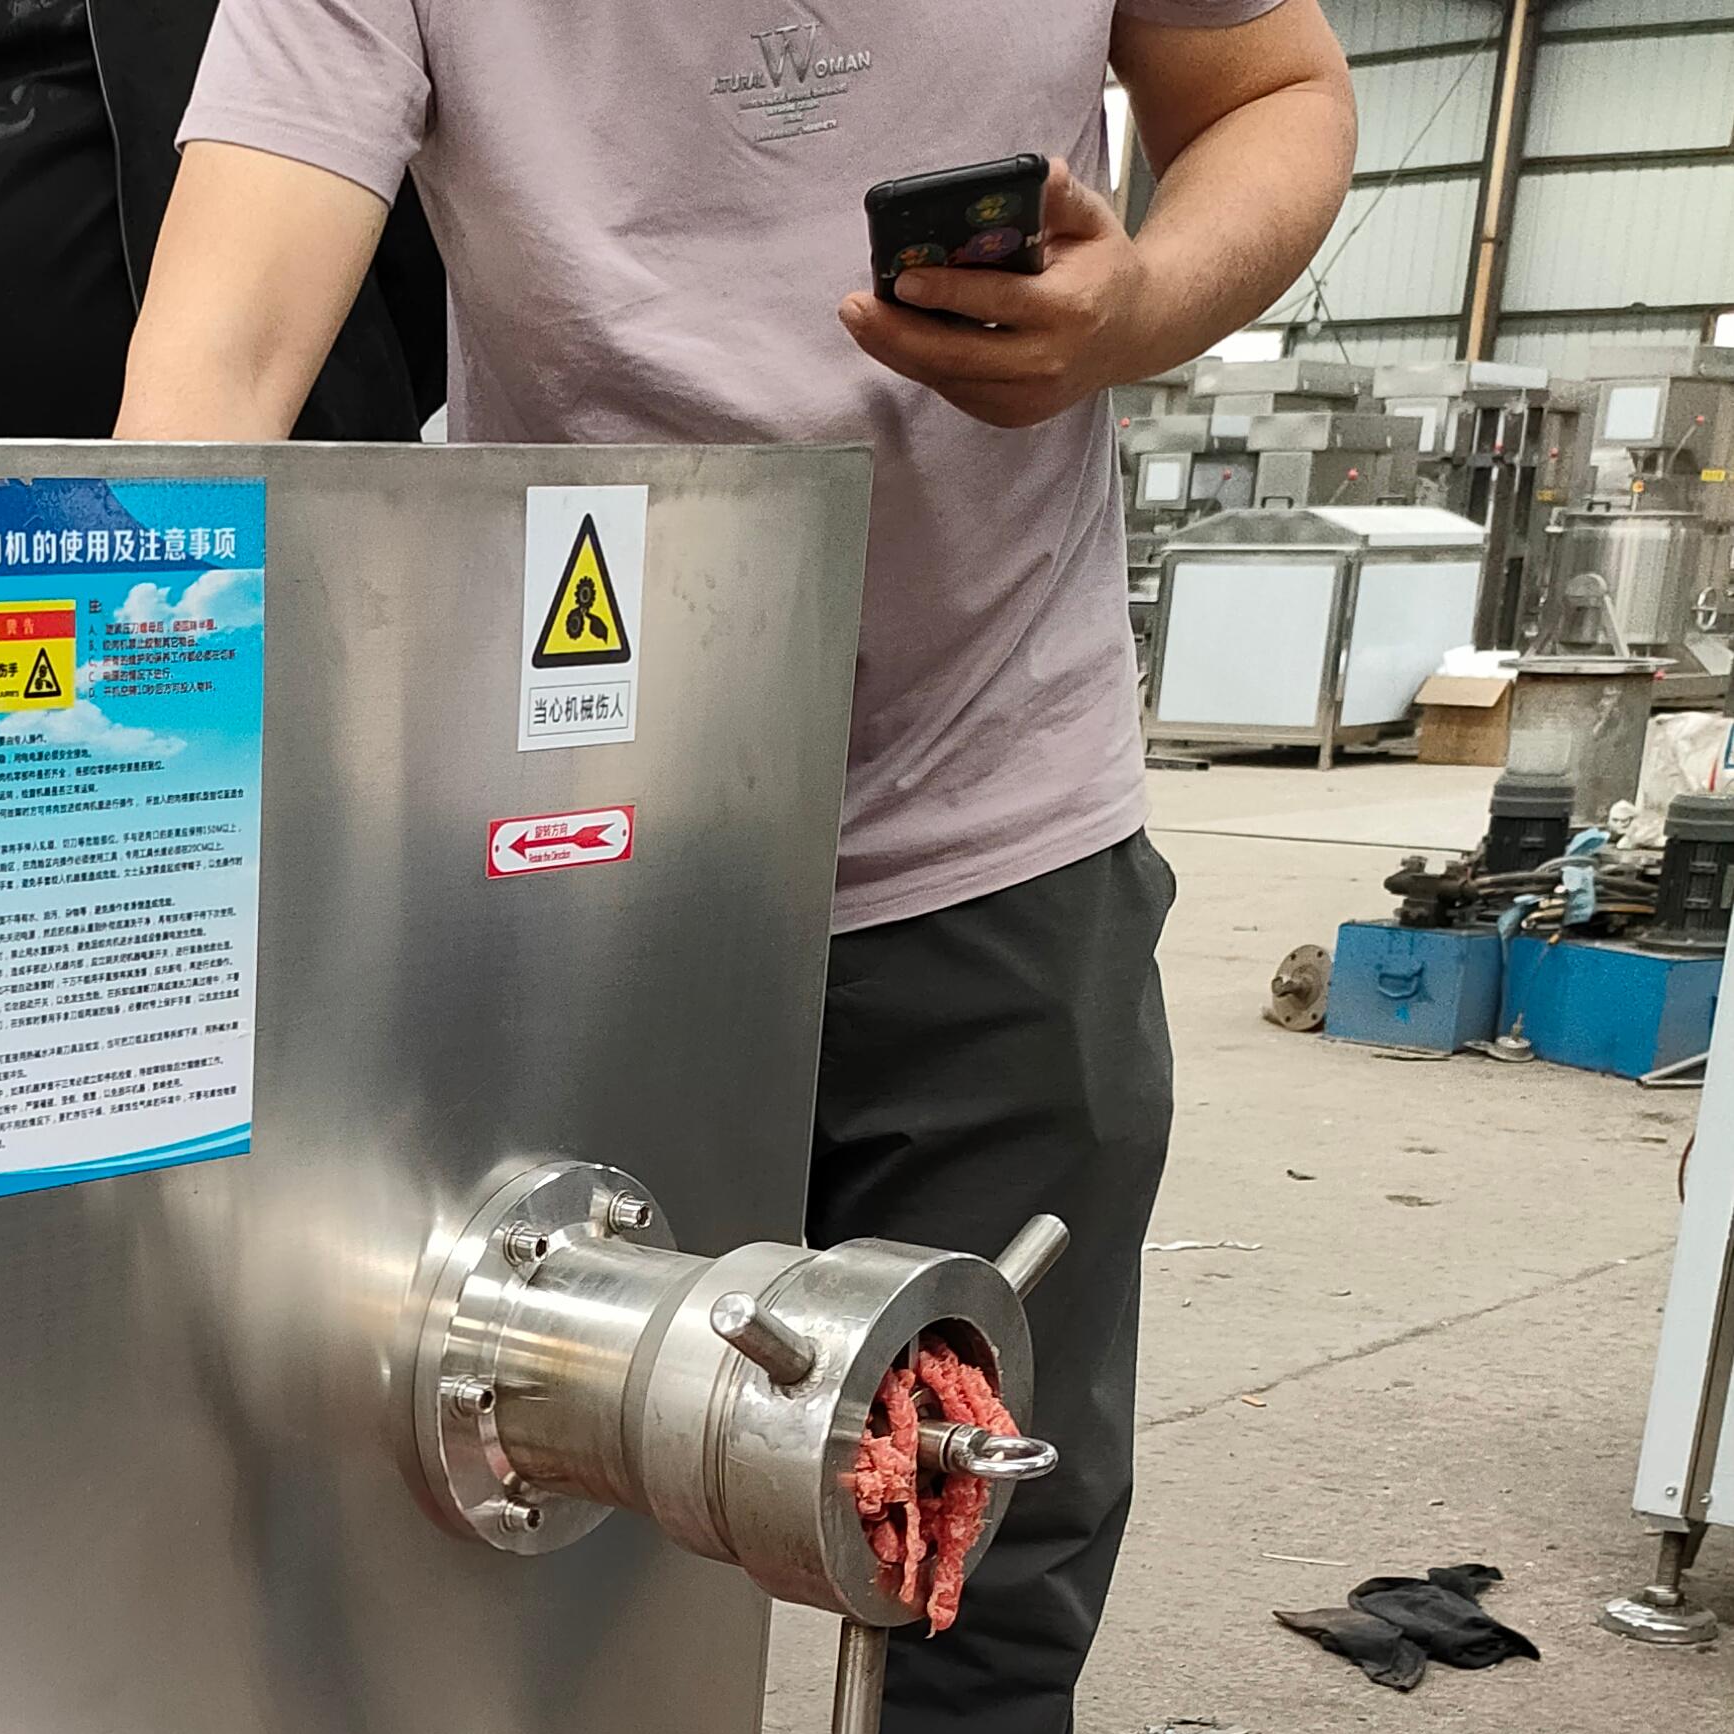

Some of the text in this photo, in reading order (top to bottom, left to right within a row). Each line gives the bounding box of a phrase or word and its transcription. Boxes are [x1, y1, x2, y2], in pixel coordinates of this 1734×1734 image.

[533, 690, 625, 726] 当心机械伤人
